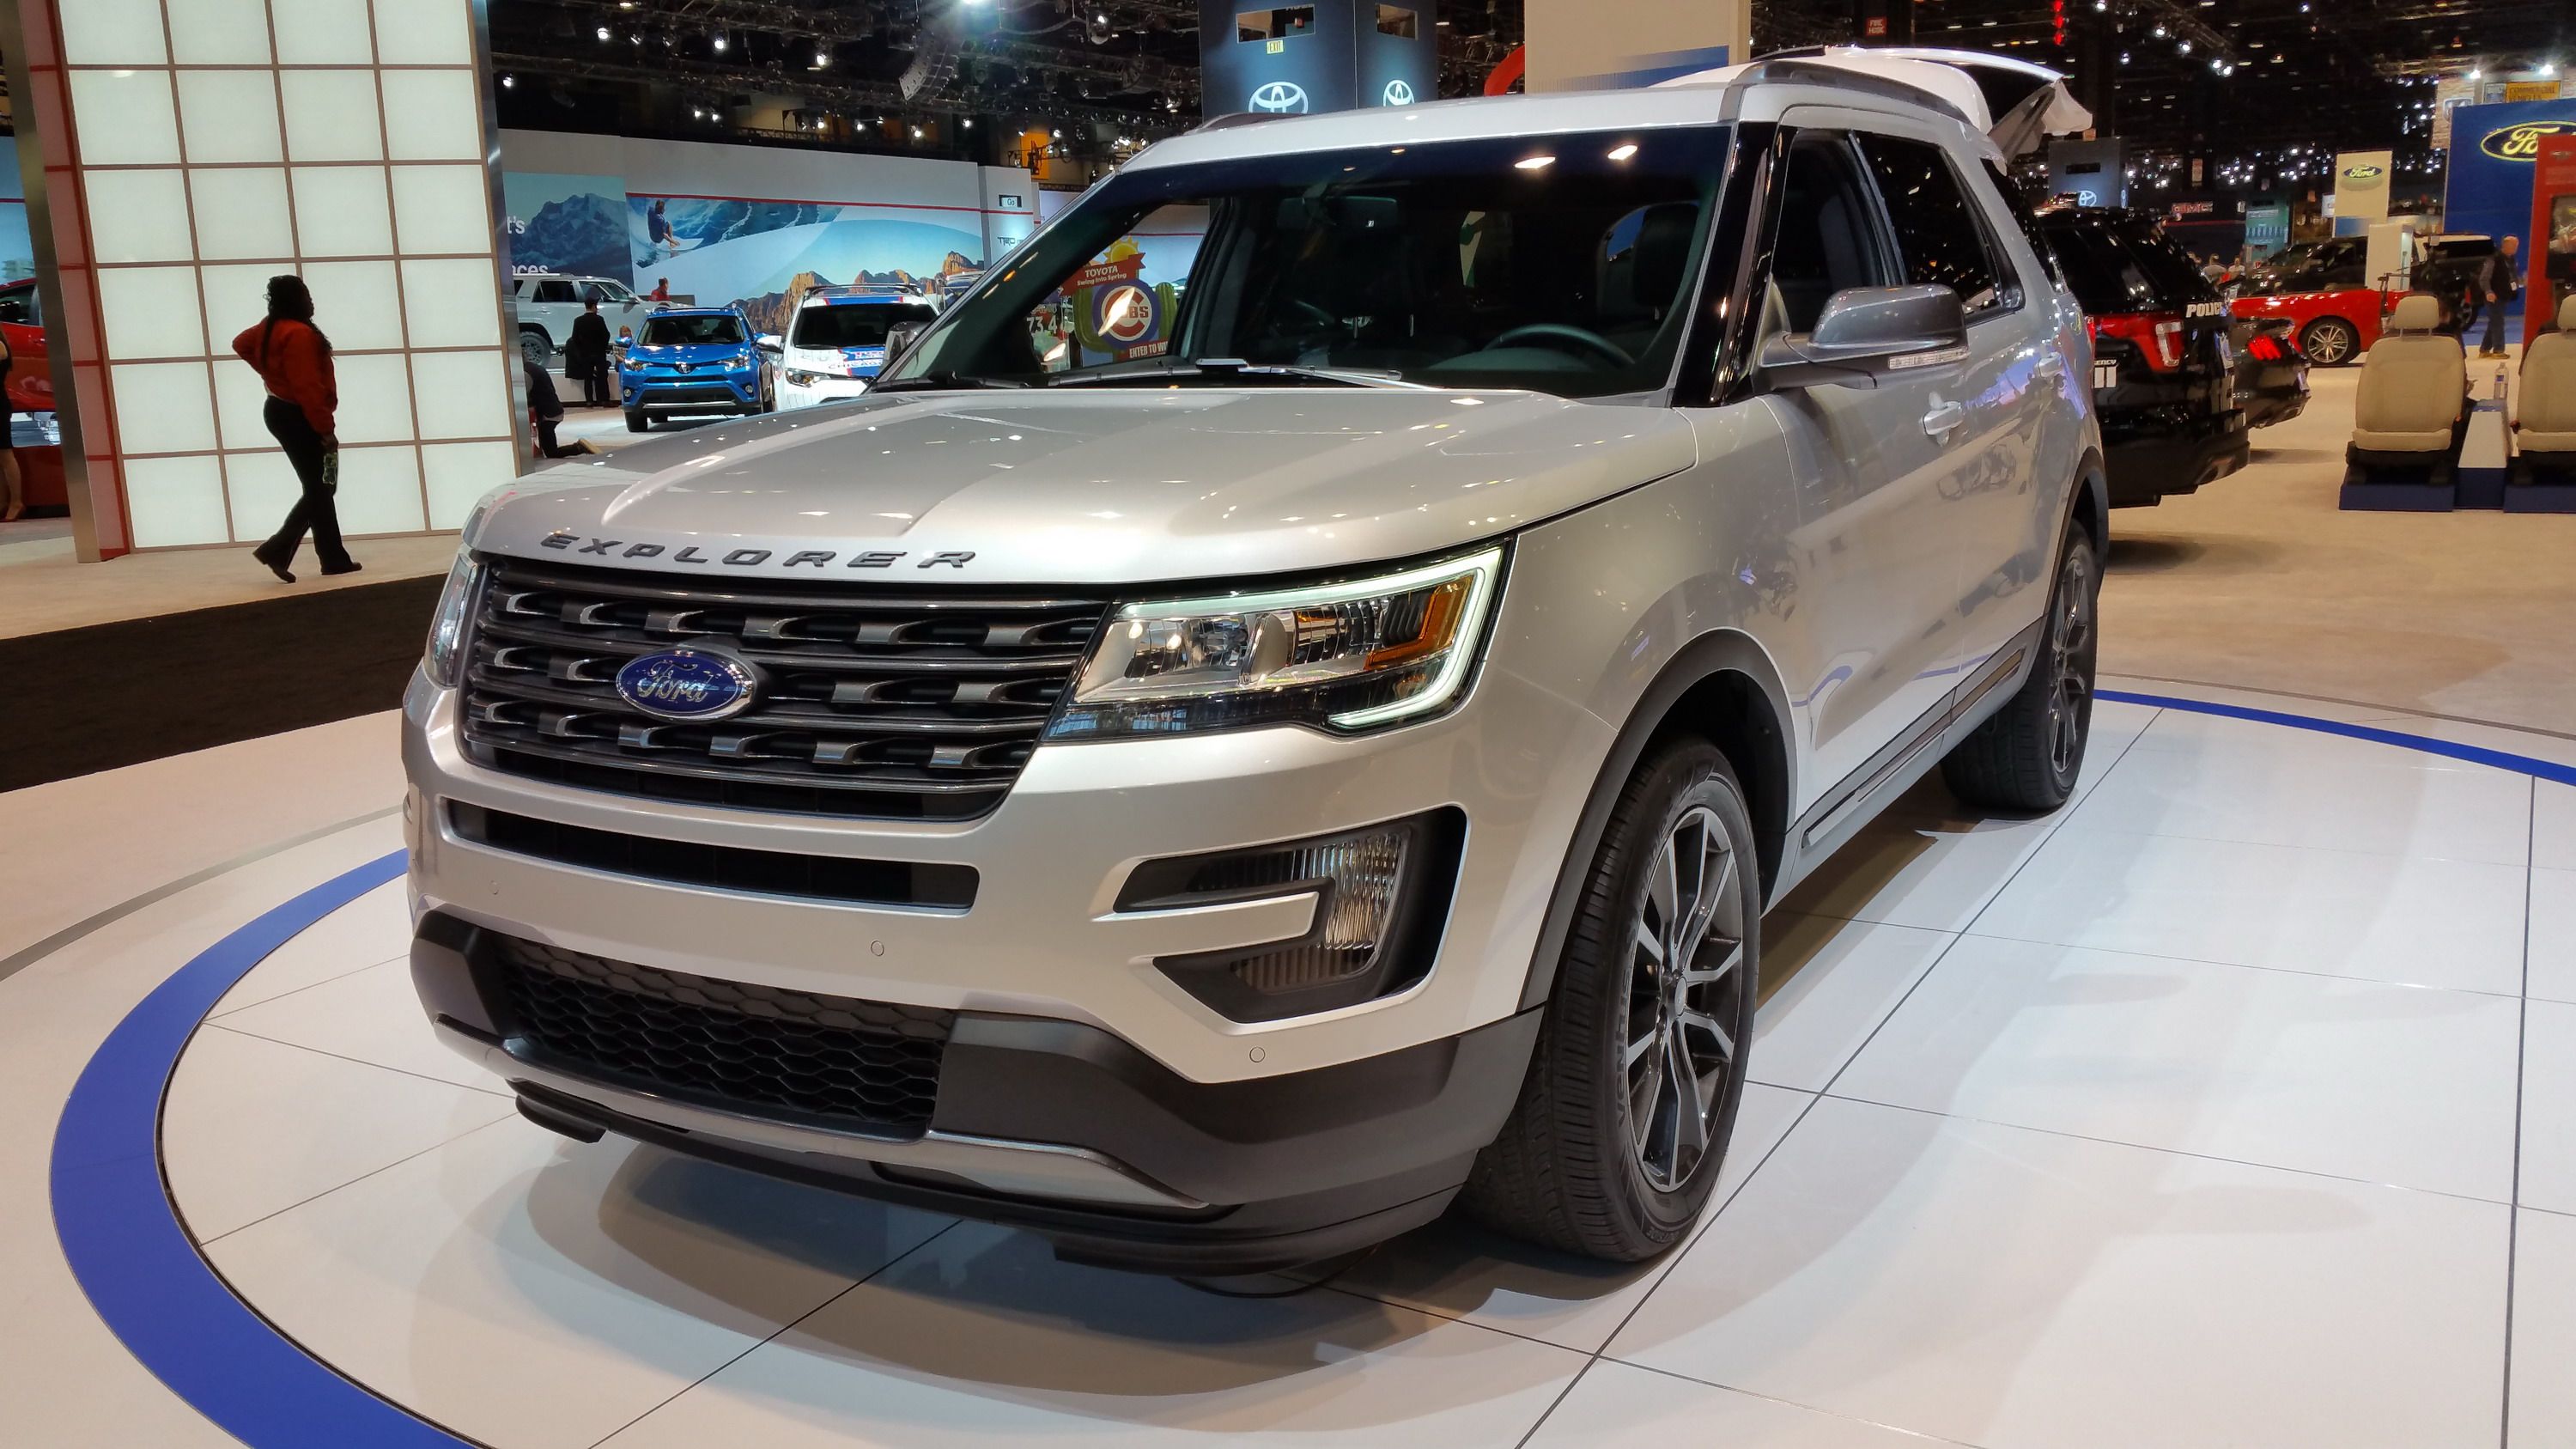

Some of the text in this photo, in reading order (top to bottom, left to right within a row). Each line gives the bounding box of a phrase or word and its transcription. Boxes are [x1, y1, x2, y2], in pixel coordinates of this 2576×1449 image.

[1269, 41, 1281, 52] EXIT
[2502, 127, 2561, 155] Fo
[2349, 164, 2377, 178] Ford
[1085, 265, 1119, 278] TOYOTA
[1108, 272, 1127, 281] Spring
[2185, 302, 2224, 318] POLIC
[1129, 345, 1148, 358] ENTER
[1148, 344, 1157, 354] TO
[540, 532, 976, 569] EXPLORER
[637, 661, 710, 703] Ford
